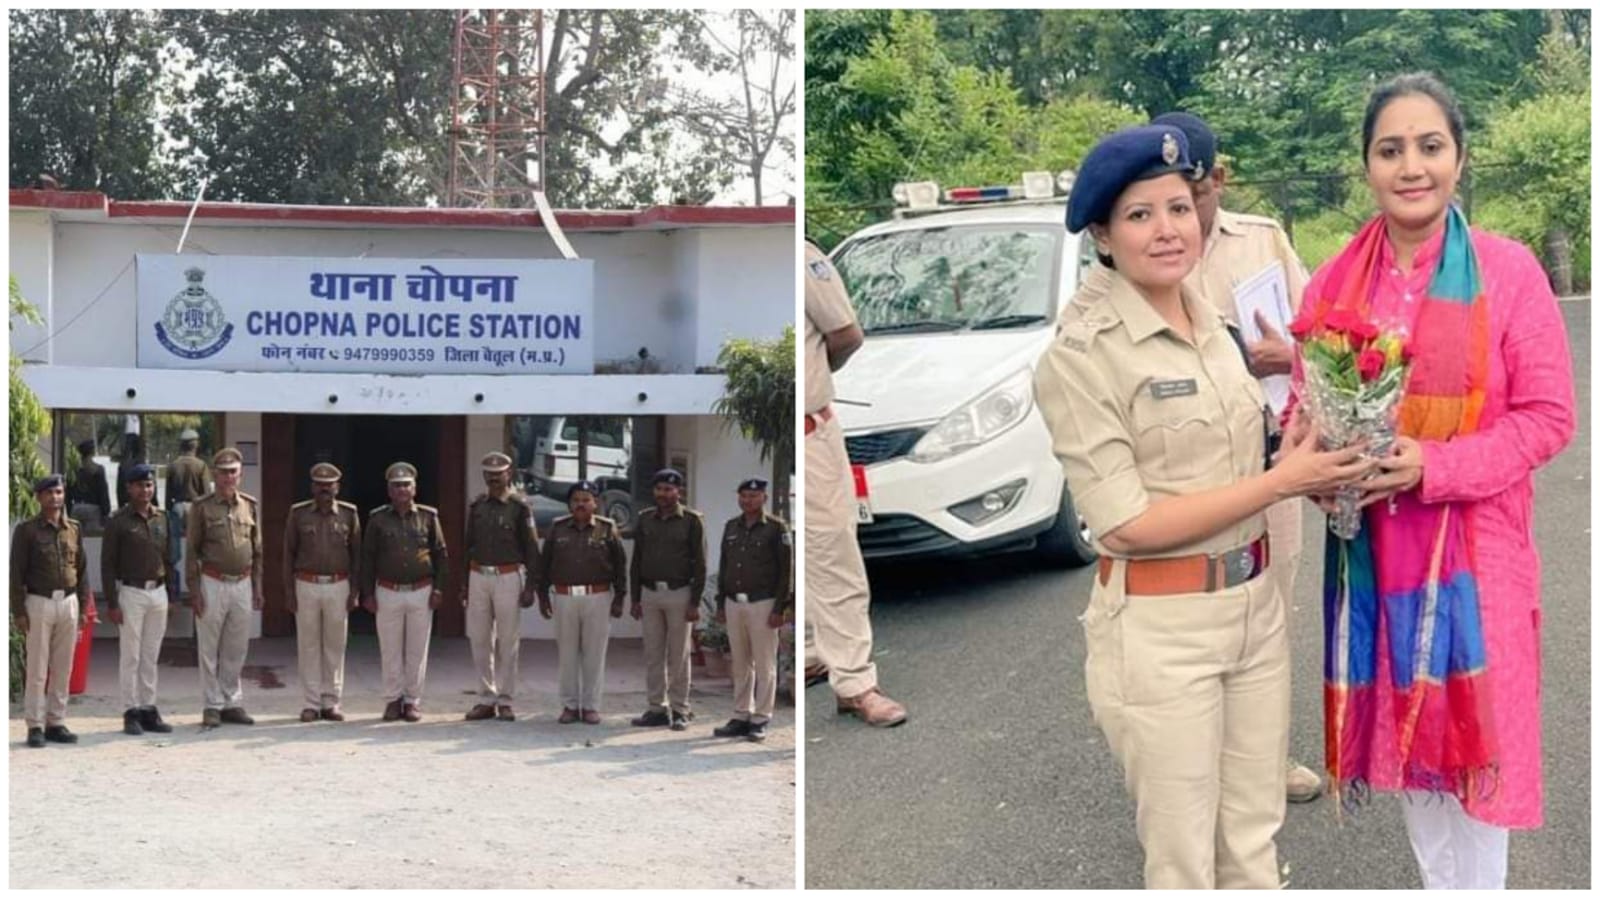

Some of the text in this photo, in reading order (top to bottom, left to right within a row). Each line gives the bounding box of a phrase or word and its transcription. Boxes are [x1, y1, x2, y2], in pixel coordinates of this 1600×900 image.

[309, 265, 519, 303] थाना चोपना
[246, 310, 581, 340] CHOPNA POLICE STATION
[261, 343, 292, 360] फोन
[295, 343, 326, 361] नंबर
[343, 347, 435, 362] 9479990359
[444, 345, 480, 362] जिला
